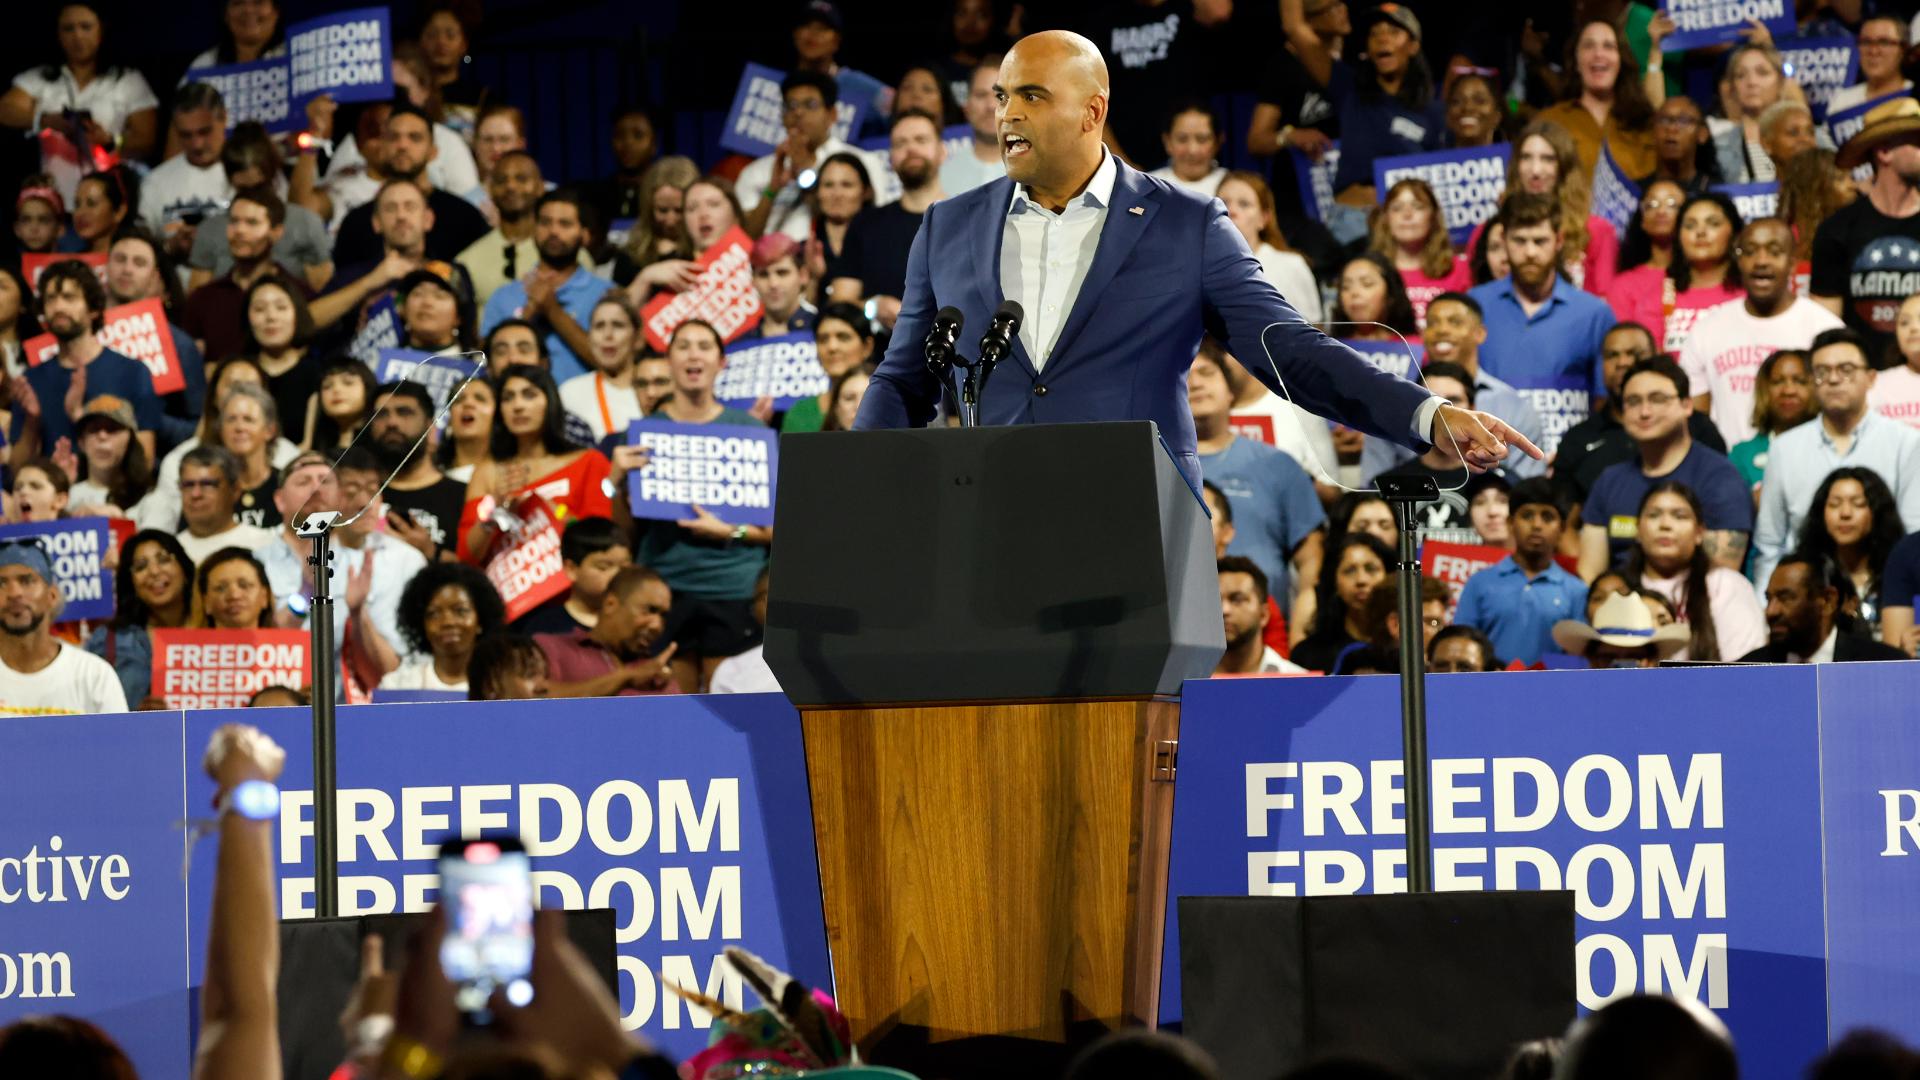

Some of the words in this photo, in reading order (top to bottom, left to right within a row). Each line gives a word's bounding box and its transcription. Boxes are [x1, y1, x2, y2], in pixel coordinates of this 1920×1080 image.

[290, 20, 381, 54] FREEDOM
[291, 40, 382, 76] FREEDOM
[291, 61, 384, 98] FREEDOM
[1850, 270, 1920, 296] KAMA
[639, 431, 768, 462] FREEDOM
[641, 478, 770, 509] FREEDOM
[166, 643, 304, 669] FREEDOM
[165, 668, 303, 694] FREEDOM
[1246, 753, 1724, 838] FREEDOM
[280, 777, 740, 864] FREEDOM
